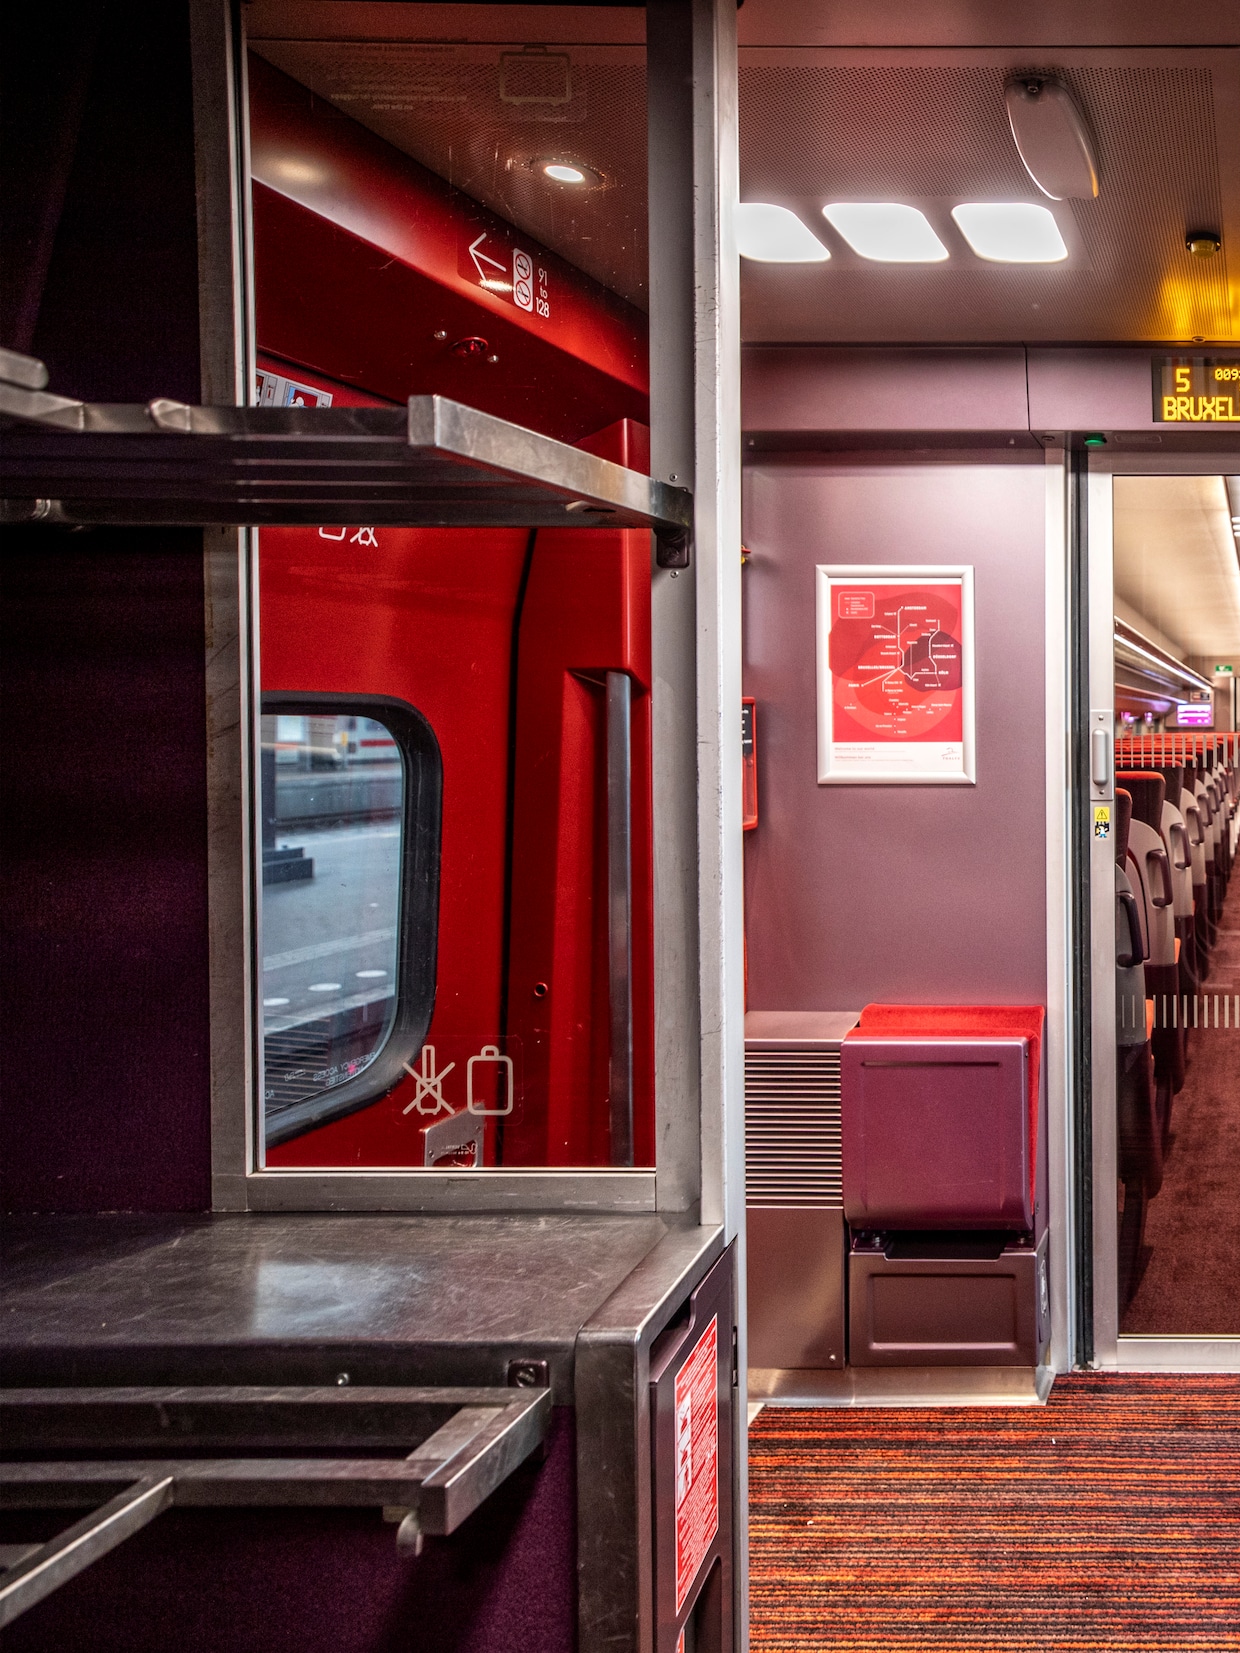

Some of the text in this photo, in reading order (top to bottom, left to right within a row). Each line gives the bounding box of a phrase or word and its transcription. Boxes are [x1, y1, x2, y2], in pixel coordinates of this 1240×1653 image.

[538, 268, 548, 286] 91
[540, 286, 548, 299] to
[536, 297, 550, 318] 128
[1176, 368, 1190, 393] 5
